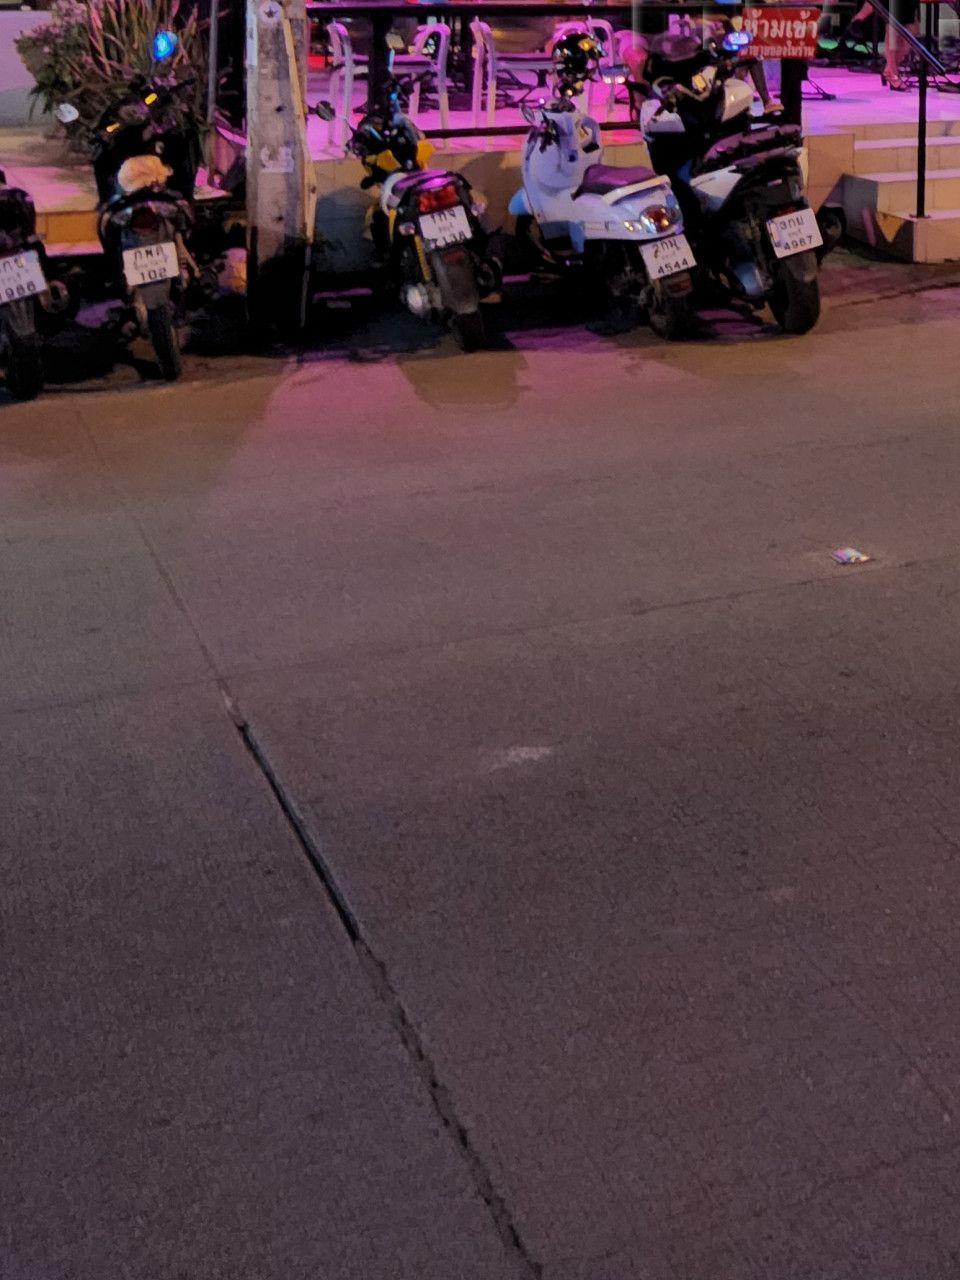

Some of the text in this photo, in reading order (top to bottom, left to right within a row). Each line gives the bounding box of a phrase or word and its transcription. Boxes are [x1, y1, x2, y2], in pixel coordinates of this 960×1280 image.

[743, 8, 819, 39] ห้ามเข้า
[140, 267, 167, 281] 102
[657, 257, 689, 274] 4544
